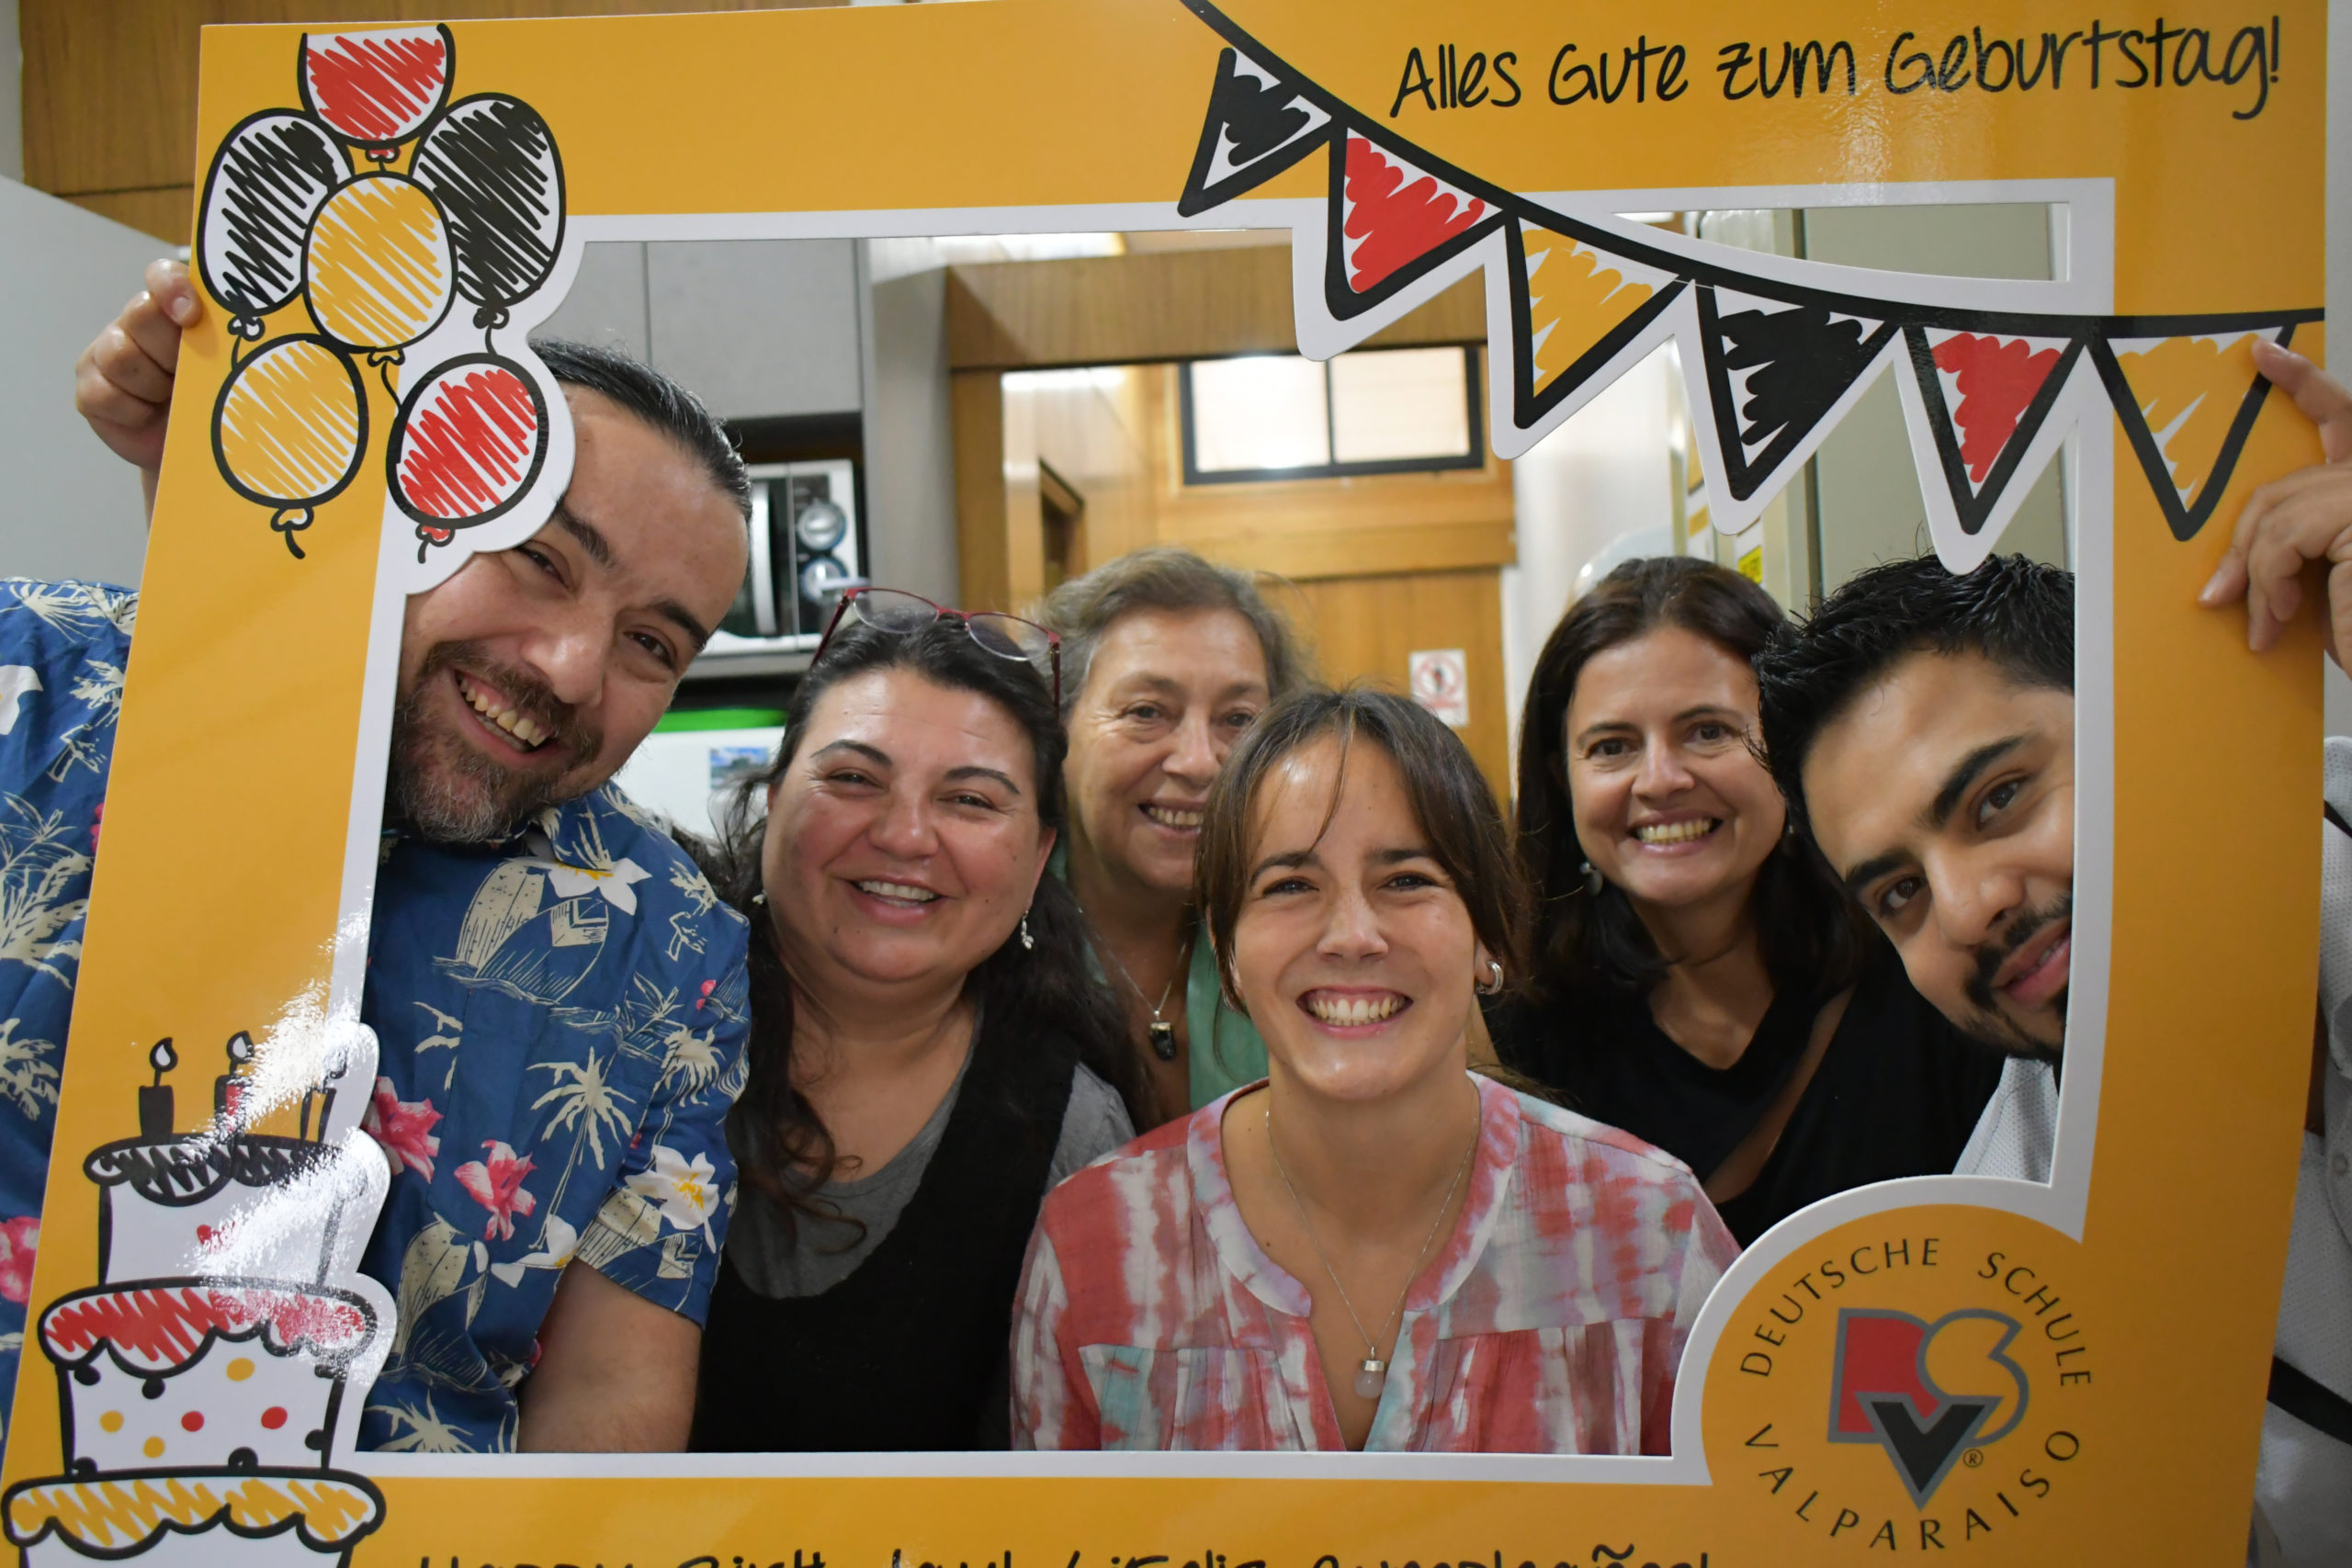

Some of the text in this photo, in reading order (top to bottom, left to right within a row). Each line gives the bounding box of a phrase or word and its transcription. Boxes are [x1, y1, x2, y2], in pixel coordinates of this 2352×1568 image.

[1389, 14, 2282, 121] Alles Gute zum Geburtstag!
[1739, 1237, 2092, 1388] DEUTSCHE SCHULE
[1744, 1422, 2081, 1551] VALPARAISO
